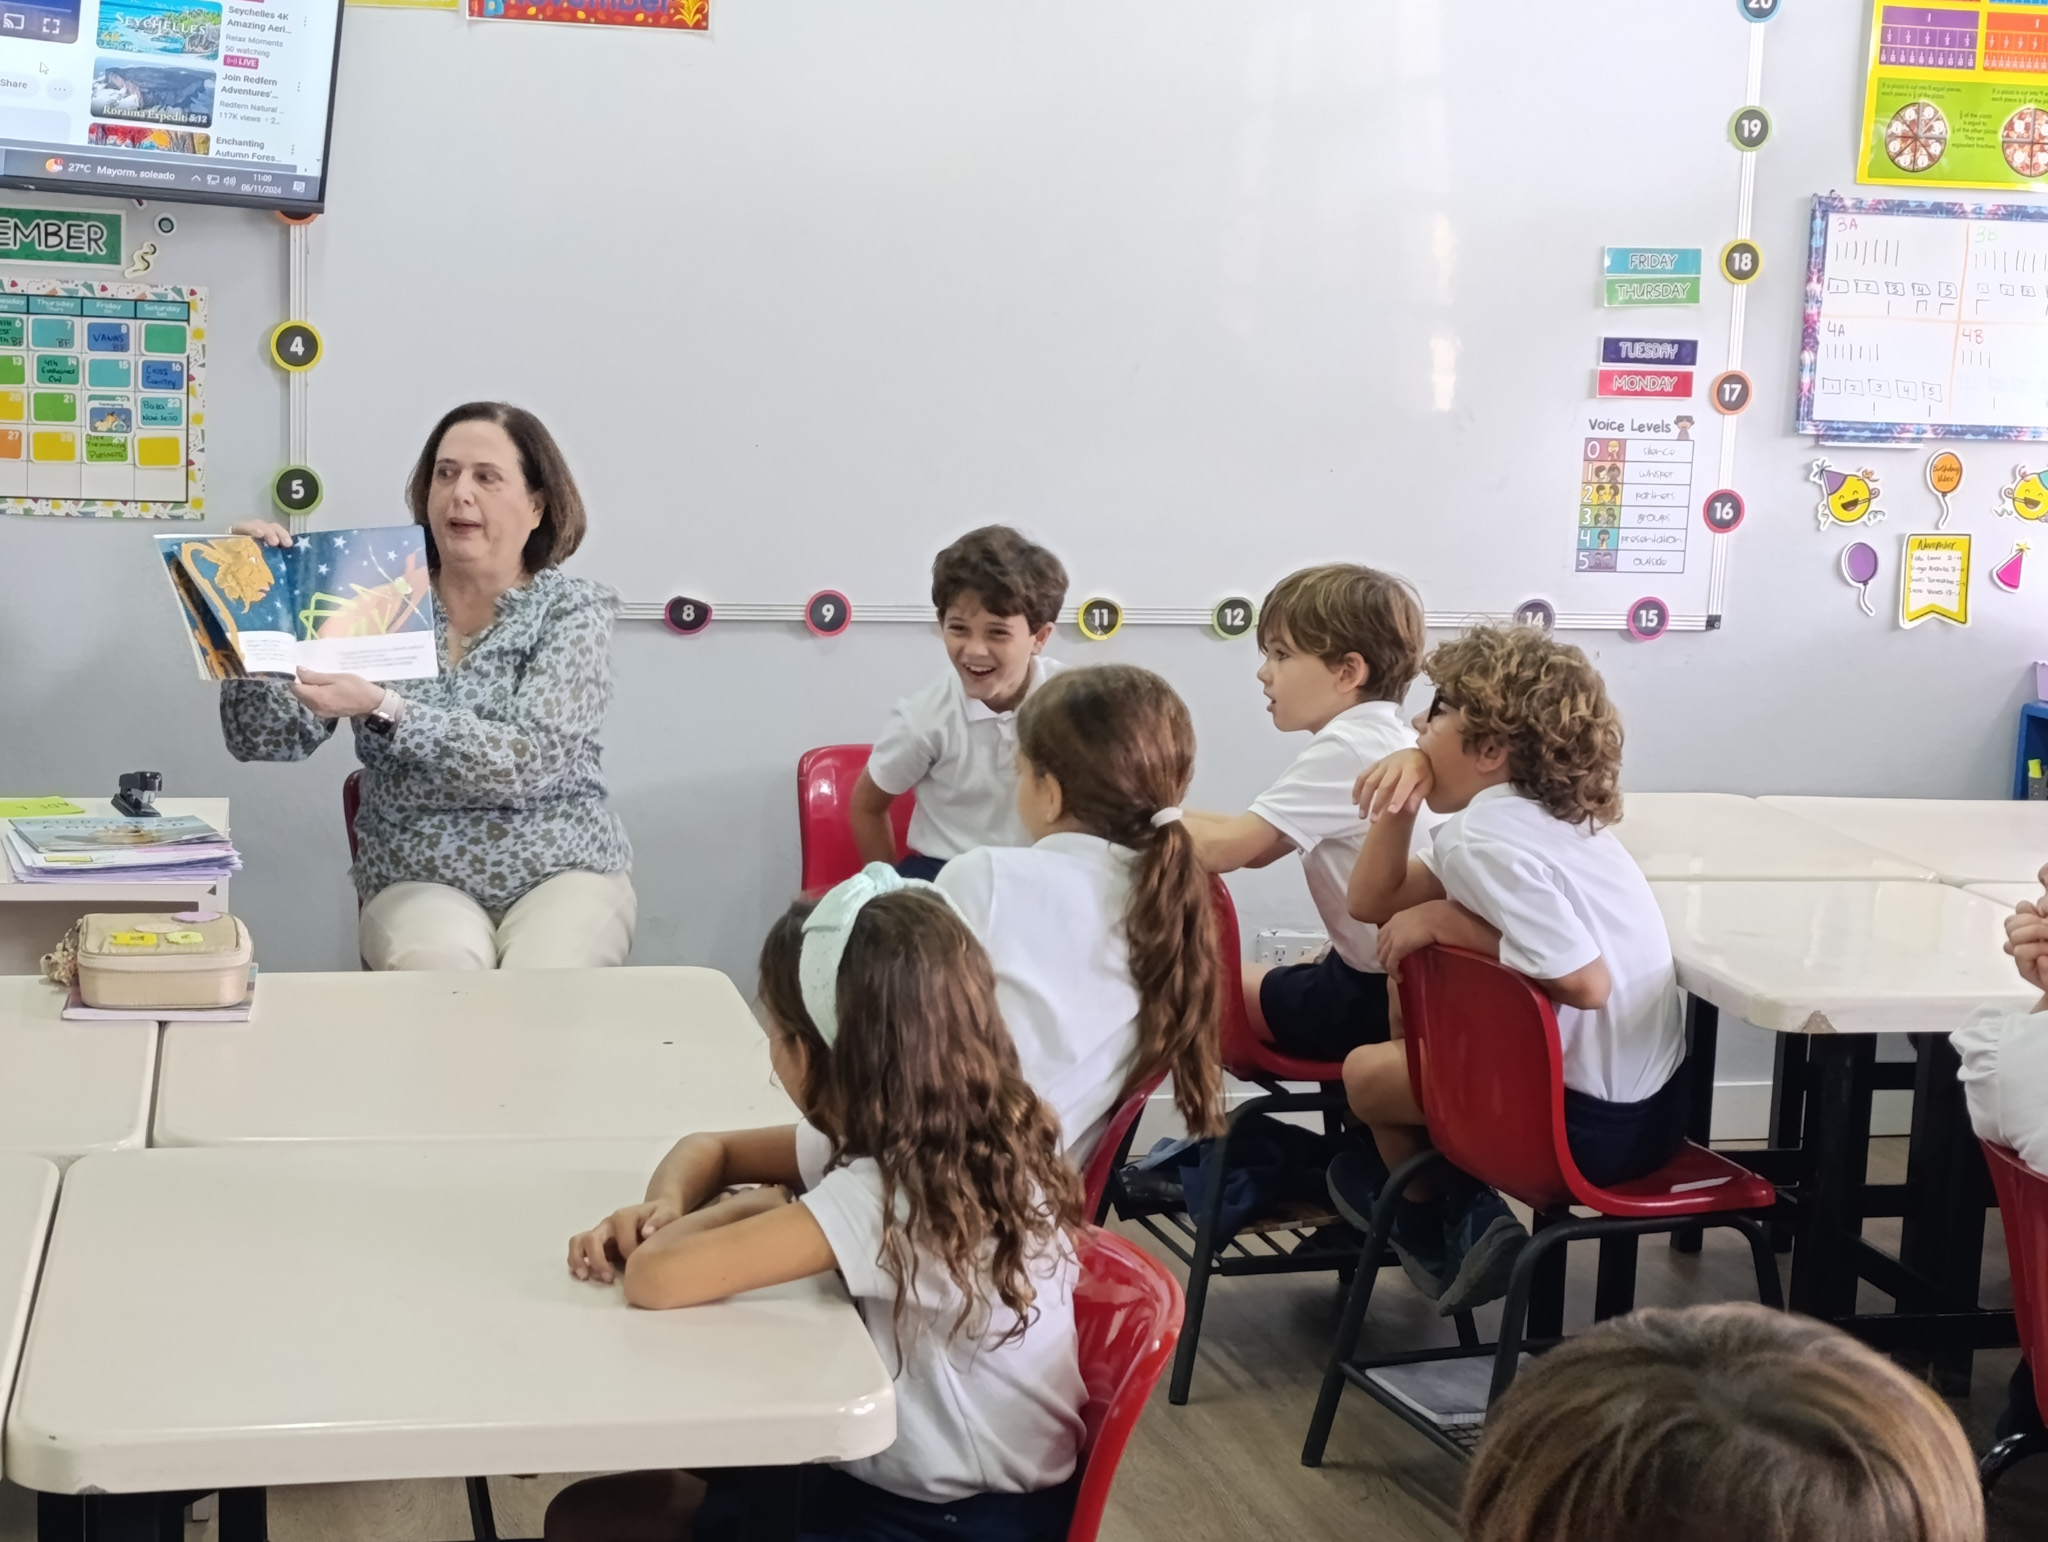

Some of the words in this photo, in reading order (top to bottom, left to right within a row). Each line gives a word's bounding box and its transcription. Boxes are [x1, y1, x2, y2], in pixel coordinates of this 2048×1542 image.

[229, 6, 275, 19] Seychelles
[116, 11, 206, 34] SEYCHELLES
[227, 19, 266, 32] Amazing
[226, 34, 246, 42] Relax
[248, 37, 283, 47] Moments
[237, 47, 270, 58] watching
[239, 59, 257, 67] LIVE
[0, 79, 28, 89] Share
[222, 73, 241, 82] Join
[244, 76, 277, 86] Redfern
[103, 105, 146, 118] Roraima
[220, 100, 249, 110] Redfern
[250, 104, 278, 113] Natural
[188, 114, 208, 124] 5:12
[219, 112, 238, 120] 117K
[240, 115, 261, 123] views
[1742, 119, 1762, 138] 19
[216, 137, 265, 150] Enchanting
[215, 150, 249, 159] Autumn
[68, 163, 91, 173] 27°C
[140, 170, 175, 180] soleado
[254, 174, 272, 182] 11:09
[1838, 218, 1858, 232] 3A
[1630, 254, 1678, 269] FRIDAY
[1733, 253, 1752, 271] 18
[1616, 284, 1690, 300] THURSDAY
[1945, 285, 1953, 296] 5
[37, 299, 75, 308] Thursday
[96, 302, 122, 310] Friday
[144, 304, 181, 313] Saturday
[15, 319, 22, 328] 6
[66, 322, 72, 330] 7
[121, 325, 127, 334] 8
[1828, 321, 1846, 336] 4A
[1963, 329, 1984, 344] 4B
[290, 336, 305, 356] 4
[1619, 342, 1679, 359] TUESDAY
[13, 357, 22, 366] 13
[68, 357, 77, 366] 14
[119, 361, 129, 370] 15
[172, 363, 182, 372] 16
[1613, 375, 1678, 392] MONDAY
[64, 394, 74, 404] 21
[1723, 384, 1742, 402] 17
[168, 399, 180, 408] 23
[1589, 418, 1624, 432] Voice
[1631, 418, 1672, 434] Levels
[8, 431, 20, 441] 27
[1587, 441, 1600, 458] 0
[1643, 446, 1676, 456] silence
[1588, 463, 1593, 482] 1
[1639, 468, 1674, 481] whisper
[291, 480, 305, 499] 5
[1583, 485, 1593, 503] 2
[1636, 490, 1674, 501] partners
[1582, 508, 1591, 525] 3
[1637, 513, 1670, 524] groups
[1715, 502, 1734, 520] 16
[1580, 529, 1591, 548] 4
[1621, 533, 1682, 545] presentation
[1578, 552, 1590, 570] 5
[1633, 556, 1667, 567] outside
[682, 604, 696, 622] 8
[822, 604, 835, 623] 9
[1092, 608, 1109, 626] 11
[1225, 608, 1245, 626] 12
[1526, 611, 1545, 628] 14
[1639, 610, 1658, 628] 15
